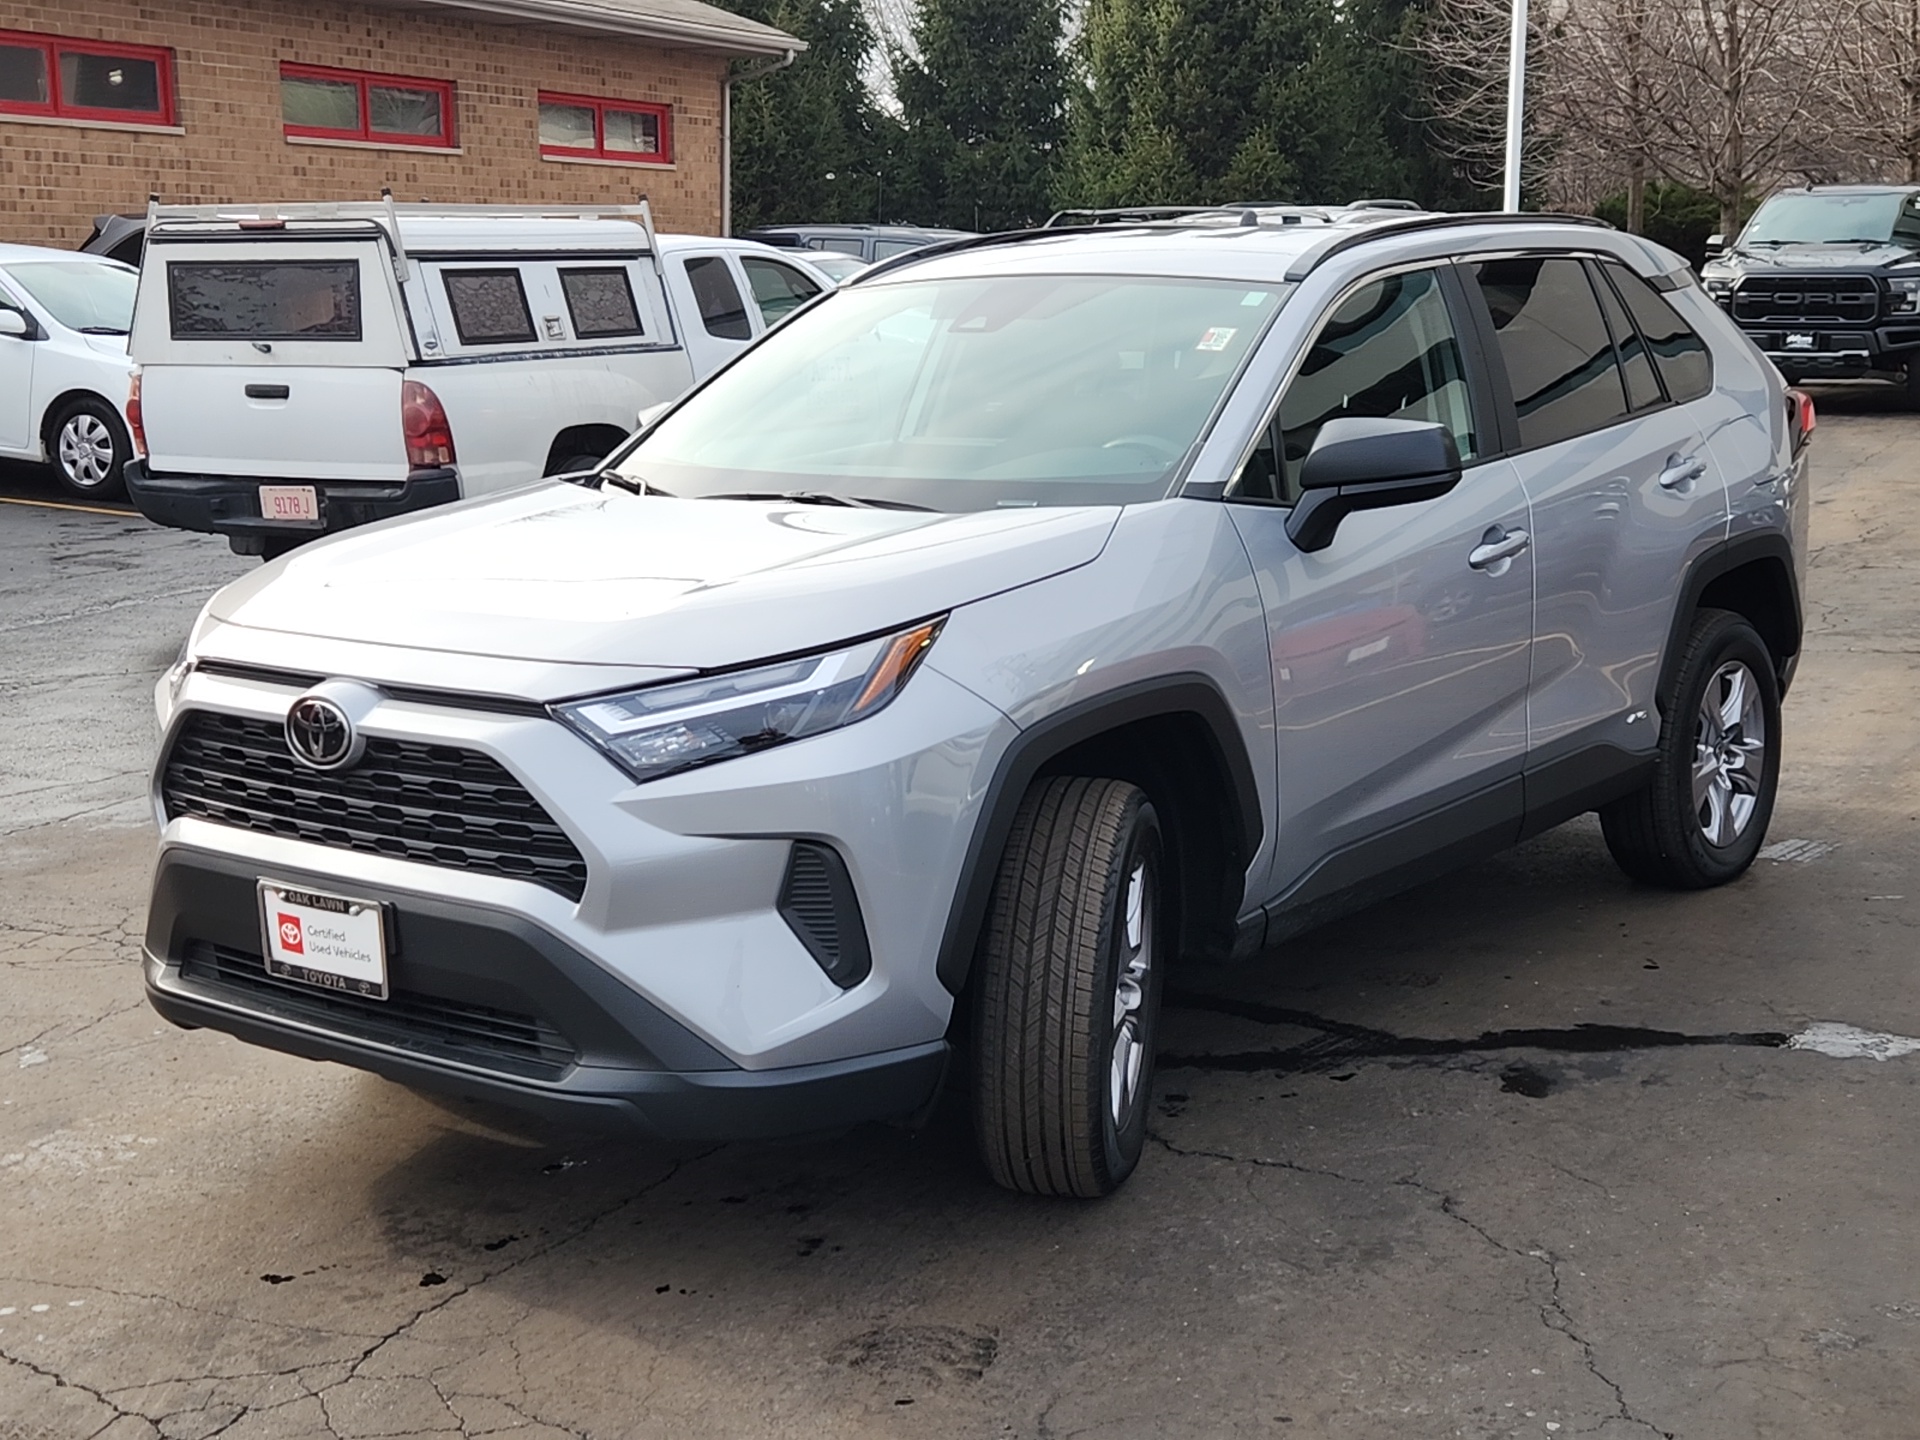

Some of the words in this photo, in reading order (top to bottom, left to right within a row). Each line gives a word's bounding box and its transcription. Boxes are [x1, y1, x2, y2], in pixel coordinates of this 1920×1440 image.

[1737, 292, 1876, 304] FORD
[274, 496, 300, 514] 9178
[288, 891, 311, 906] OAK
[312, 895, 345, 912] LAWN
[307, 924, 346, 942] Certified
[308, 940, 332, 956] Used
[333, 945, 372, 963] Vehicles
[301, 968, 347, 989] TOYOTA
